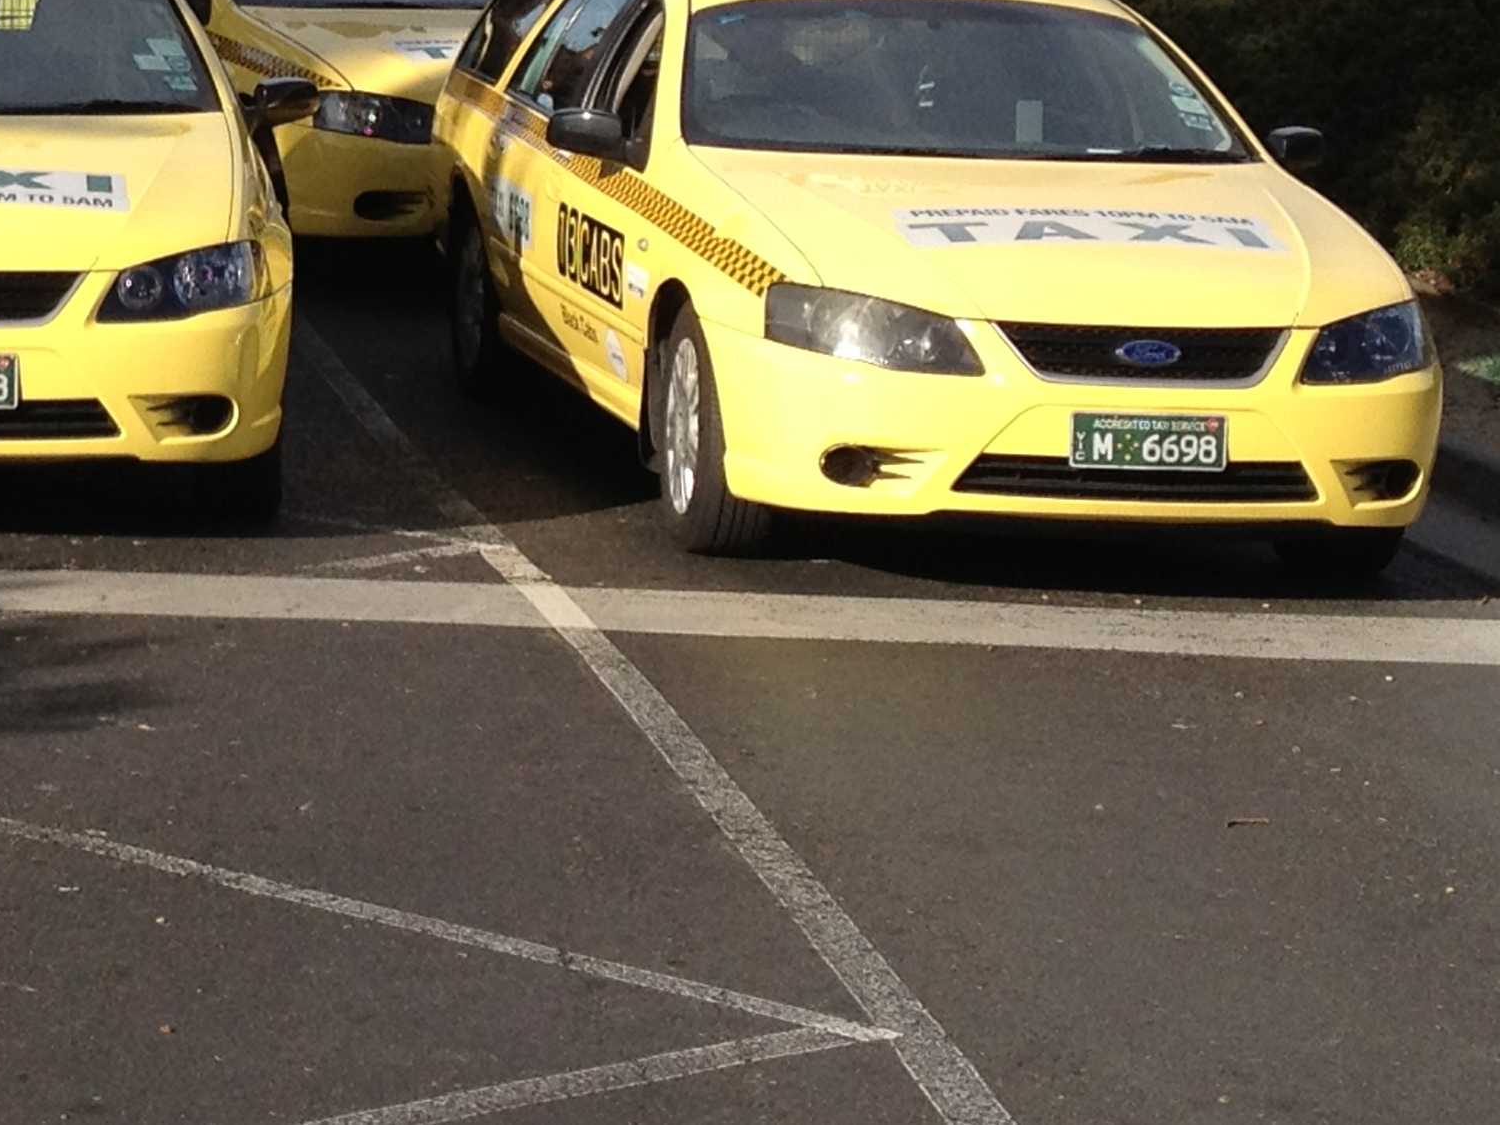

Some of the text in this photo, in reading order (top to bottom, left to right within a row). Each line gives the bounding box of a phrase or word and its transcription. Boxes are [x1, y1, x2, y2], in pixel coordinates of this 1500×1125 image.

[27, 192, 55, 204] TO
[63, 196, 115, 209] 5AM
[909, 208, 1009, 219] PREPAID
[1014, 208, 1090, 218] FARES
[1095, 209, 1162, 221] 10PM
[1168, 212, 1197, 223] TO
[907, 220, 1271, 249] TAXI
[1092, 432, 1218, 464] M 6698
